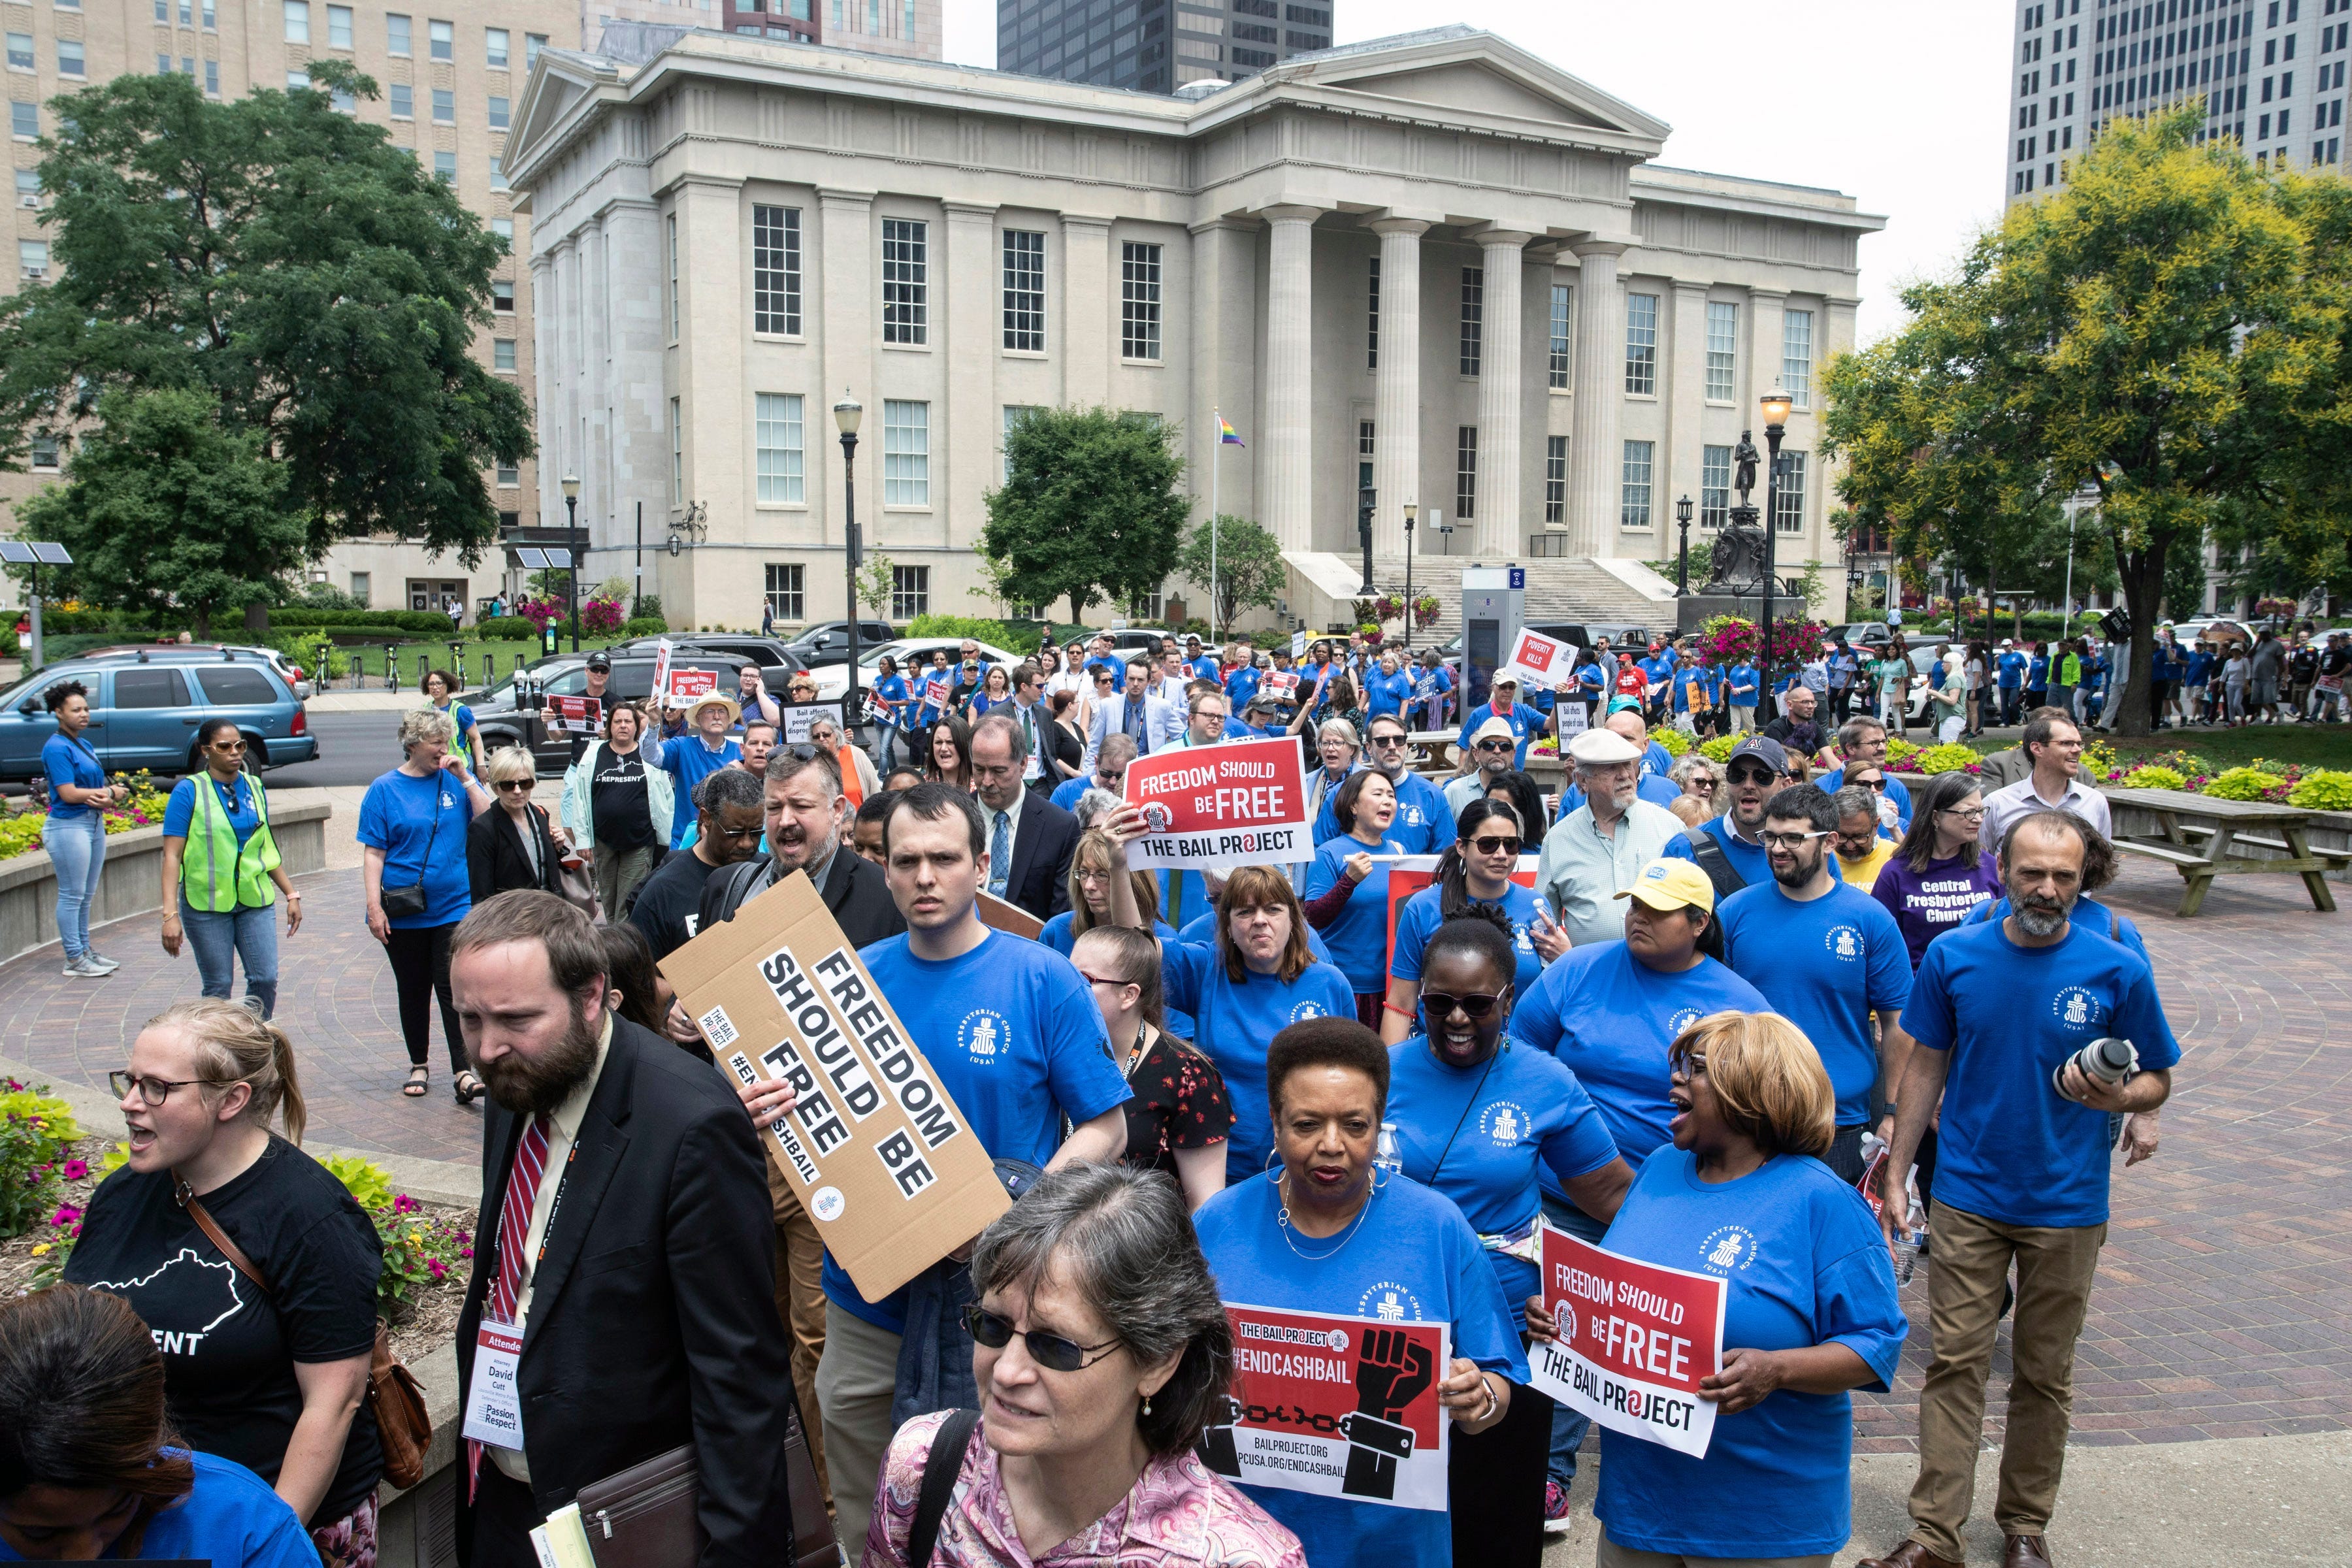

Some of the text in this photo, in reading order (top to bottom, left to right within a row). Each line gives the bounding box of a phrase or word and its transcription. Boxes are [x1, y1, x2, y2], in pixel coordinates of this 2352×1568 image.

[1526, 653, 1542, 665] KILLS
[1527, 640, 1551, 655] POVERTY
[1562, 720, 1573, 729] people
[1140, 761, 1275, 797] FREEDOM SHOULD
[1194, 785, 1286, 820] BE FREE
[1141, 830, 1294, 857] THE BAIL PROJECT
[1906, 890, 1992, 908] Presbyterian
[1921, 879, 1972, 893] Central
[1926, 907, 1971, 923] Churc
[1825, 925, 1856, 950] PRESBYTERIAN
[1290, 1000, 1321, 1024] RESBYTERIAN
[2053, 986, 2100, 1022] PRESBYTERIAN CHURCH
[702, 1016, 726, 1046] PROJECT
[711, 1009, 734, 1041] THE BAIL
[958, 1009, 1011, 1054] PRESBYTERIAN CHURCH
[816, 951, 958, 1148] FREEDOM
[970, 1056, 994, 1065] (USA)
[763, 953, 933, 1196] SHOULD BE
[763, 1042, 849, 1154] FREE
[732, 1056, 815, 1183] #ENSHBAIL
[1480, 1101, 1531, 1138] PRESBYTERIAN CHURCH
[1699, 1226, 1757, 1270] PRESBYTERIAN CHURCH
[1703, 1264, 1727, 1276] (USA)
[1358, 1282, 1422, 1321] ESBYTERIAN CHUR
[1556, 1262, 1684, 1325] FREEDOM SHOULD
[150, 1329, 203, 1356] ENT
[489, 1335, 521, 1352] Attende
[1240, 1323, 1262, 1338] THE
[1263, 1325, 1285, 1341] BAIL
[1286, 1329, 1327, 1347] PROJECT
[1592, 1315, 1691, 1382] BE FREE
[489, 1366, 513, 1381] David
[494, 1358, 510, 1367] Attorney
[1233, 1348, 1351, 1384] #ENDCASHBAIL
[493, 1381, 506, 1391] Cutt
[1543, 1347, 1695, 1431] THE BAIL PROJECT
[485, 1414, 516, 1430] Respect
[1254, 1437, 1328, 1458] BAILPROJECT.ORG
[1238, 1452, 1346, 1478] PCUSA.ORG/ENDCASHBAIL
